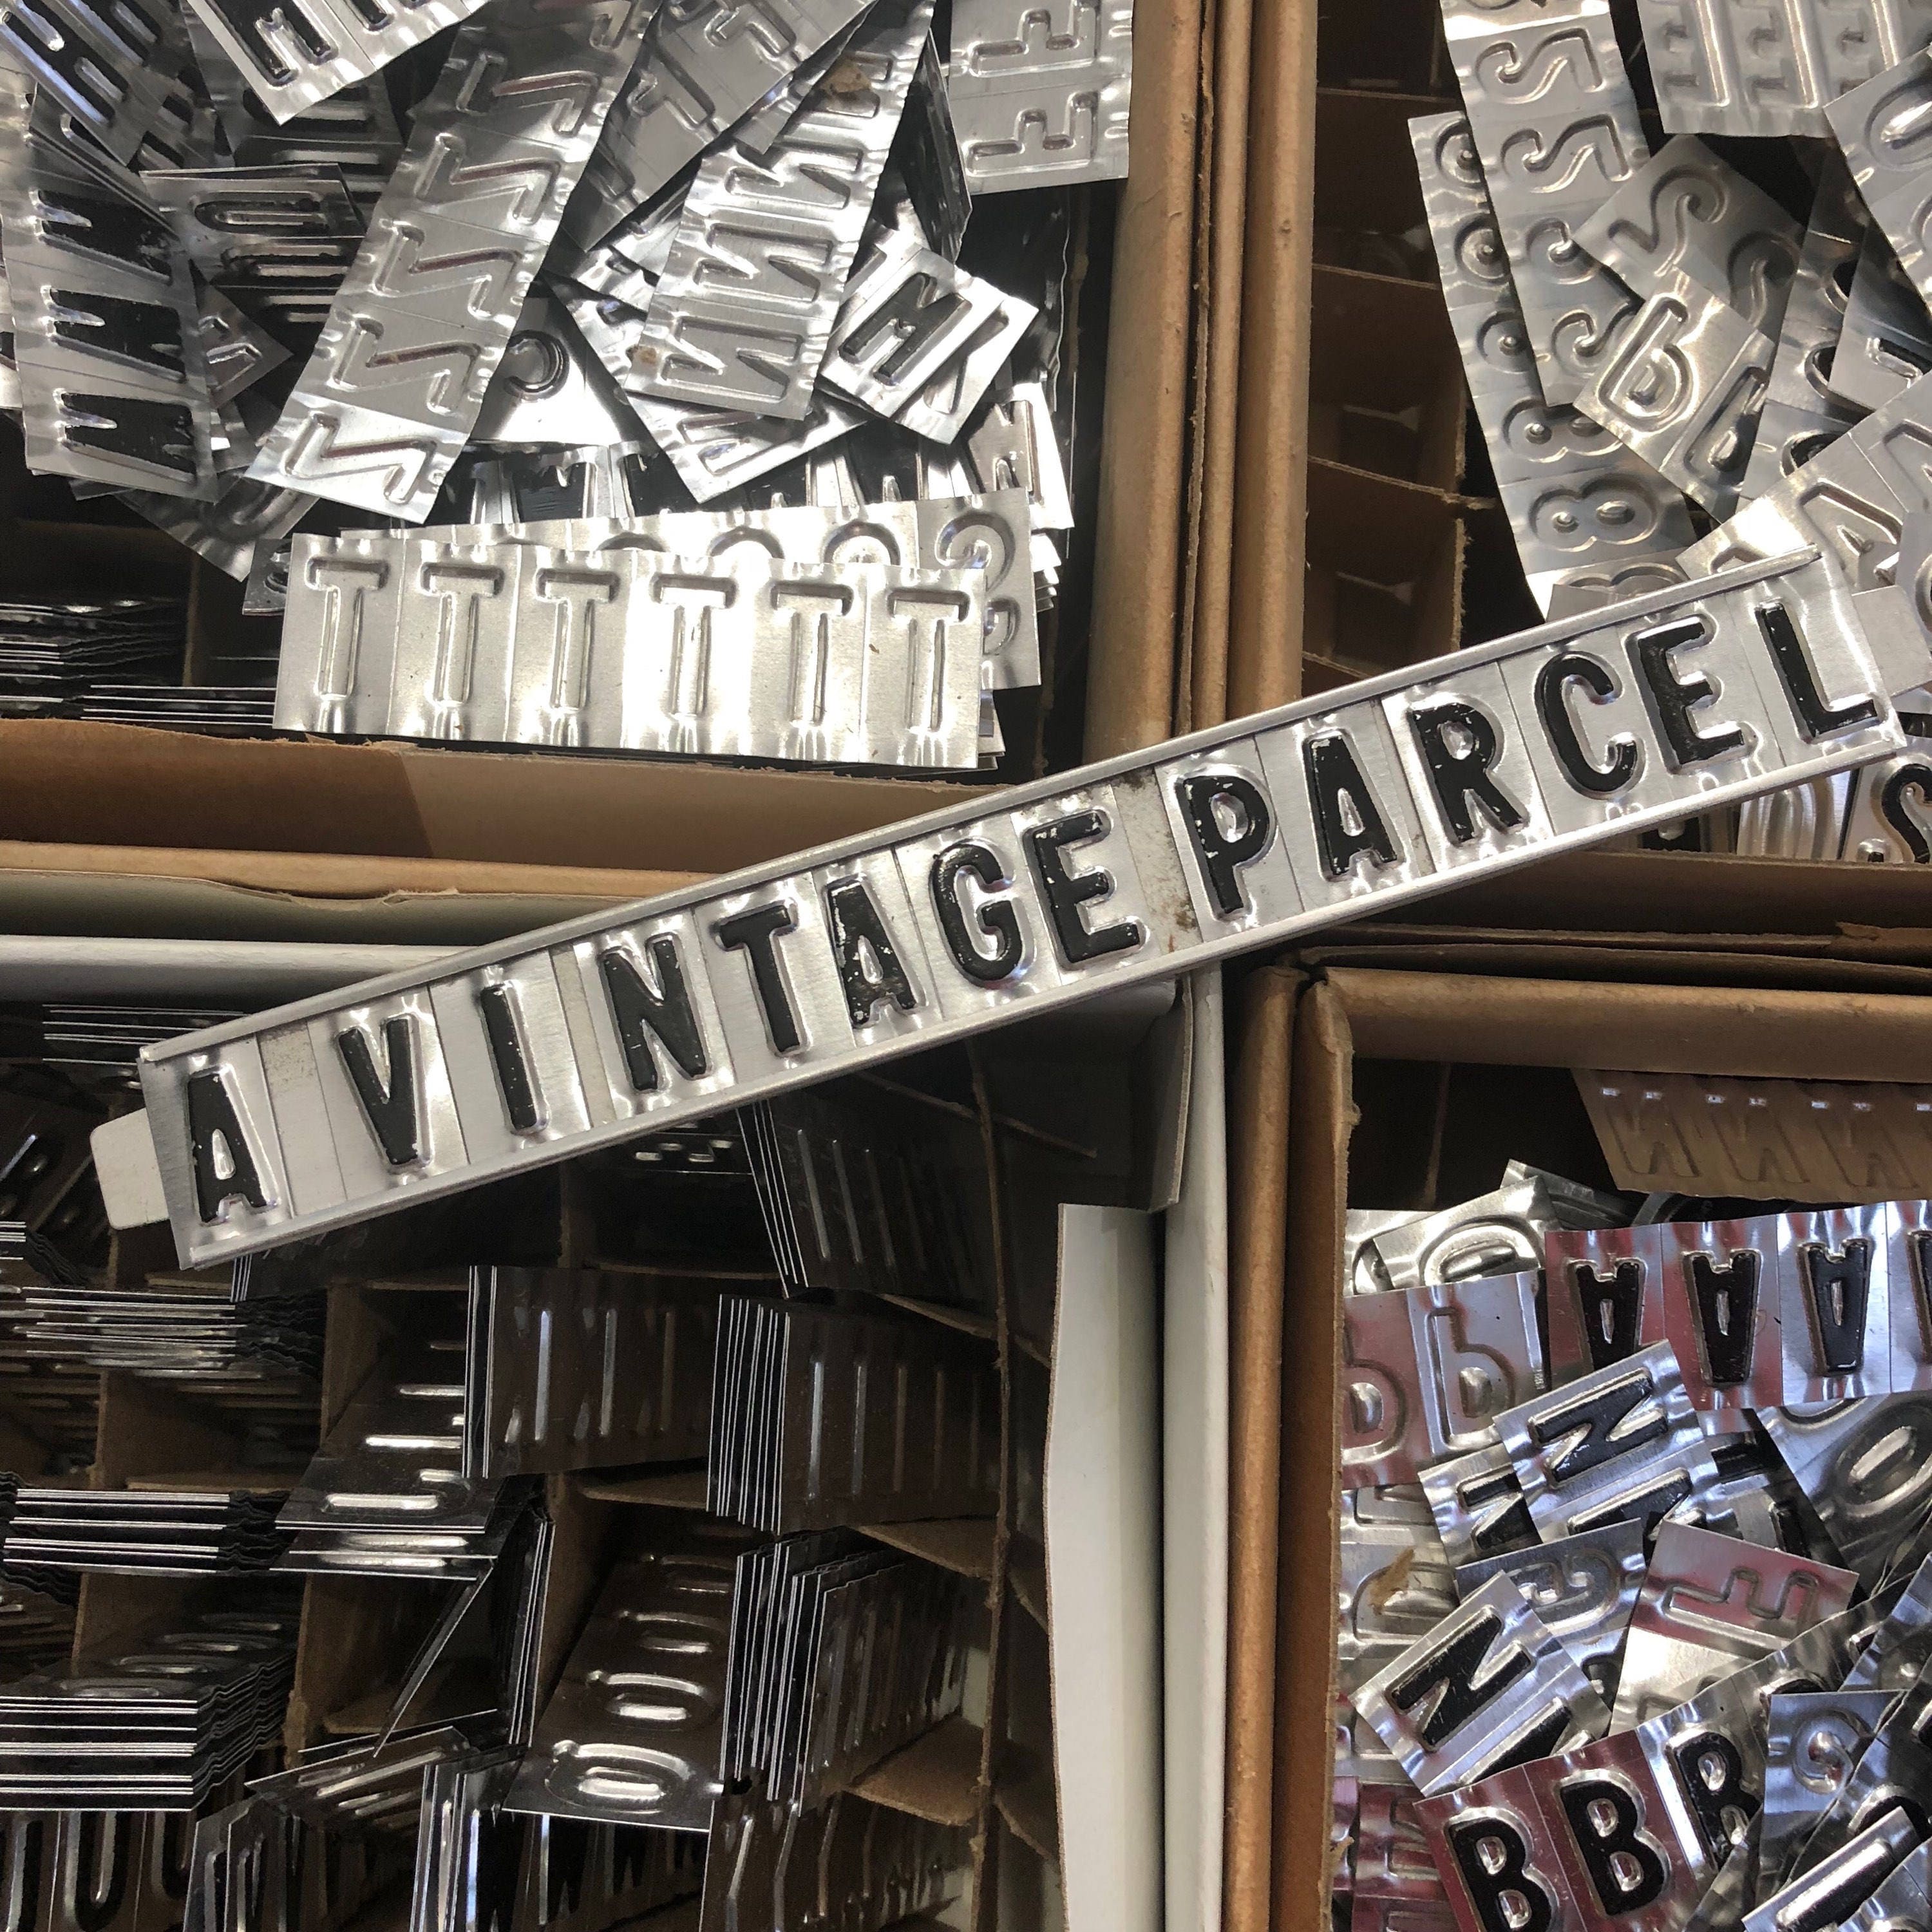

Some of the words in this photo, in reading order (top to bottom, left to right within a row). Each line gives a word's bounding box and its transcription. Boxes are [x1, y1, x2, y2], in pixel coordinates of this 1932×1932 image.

[185, 1066, 278, 1227] A
[334, 808, 1150, 1169] VINTAGE
[1174, 600, 1886, 923] PARCEL
